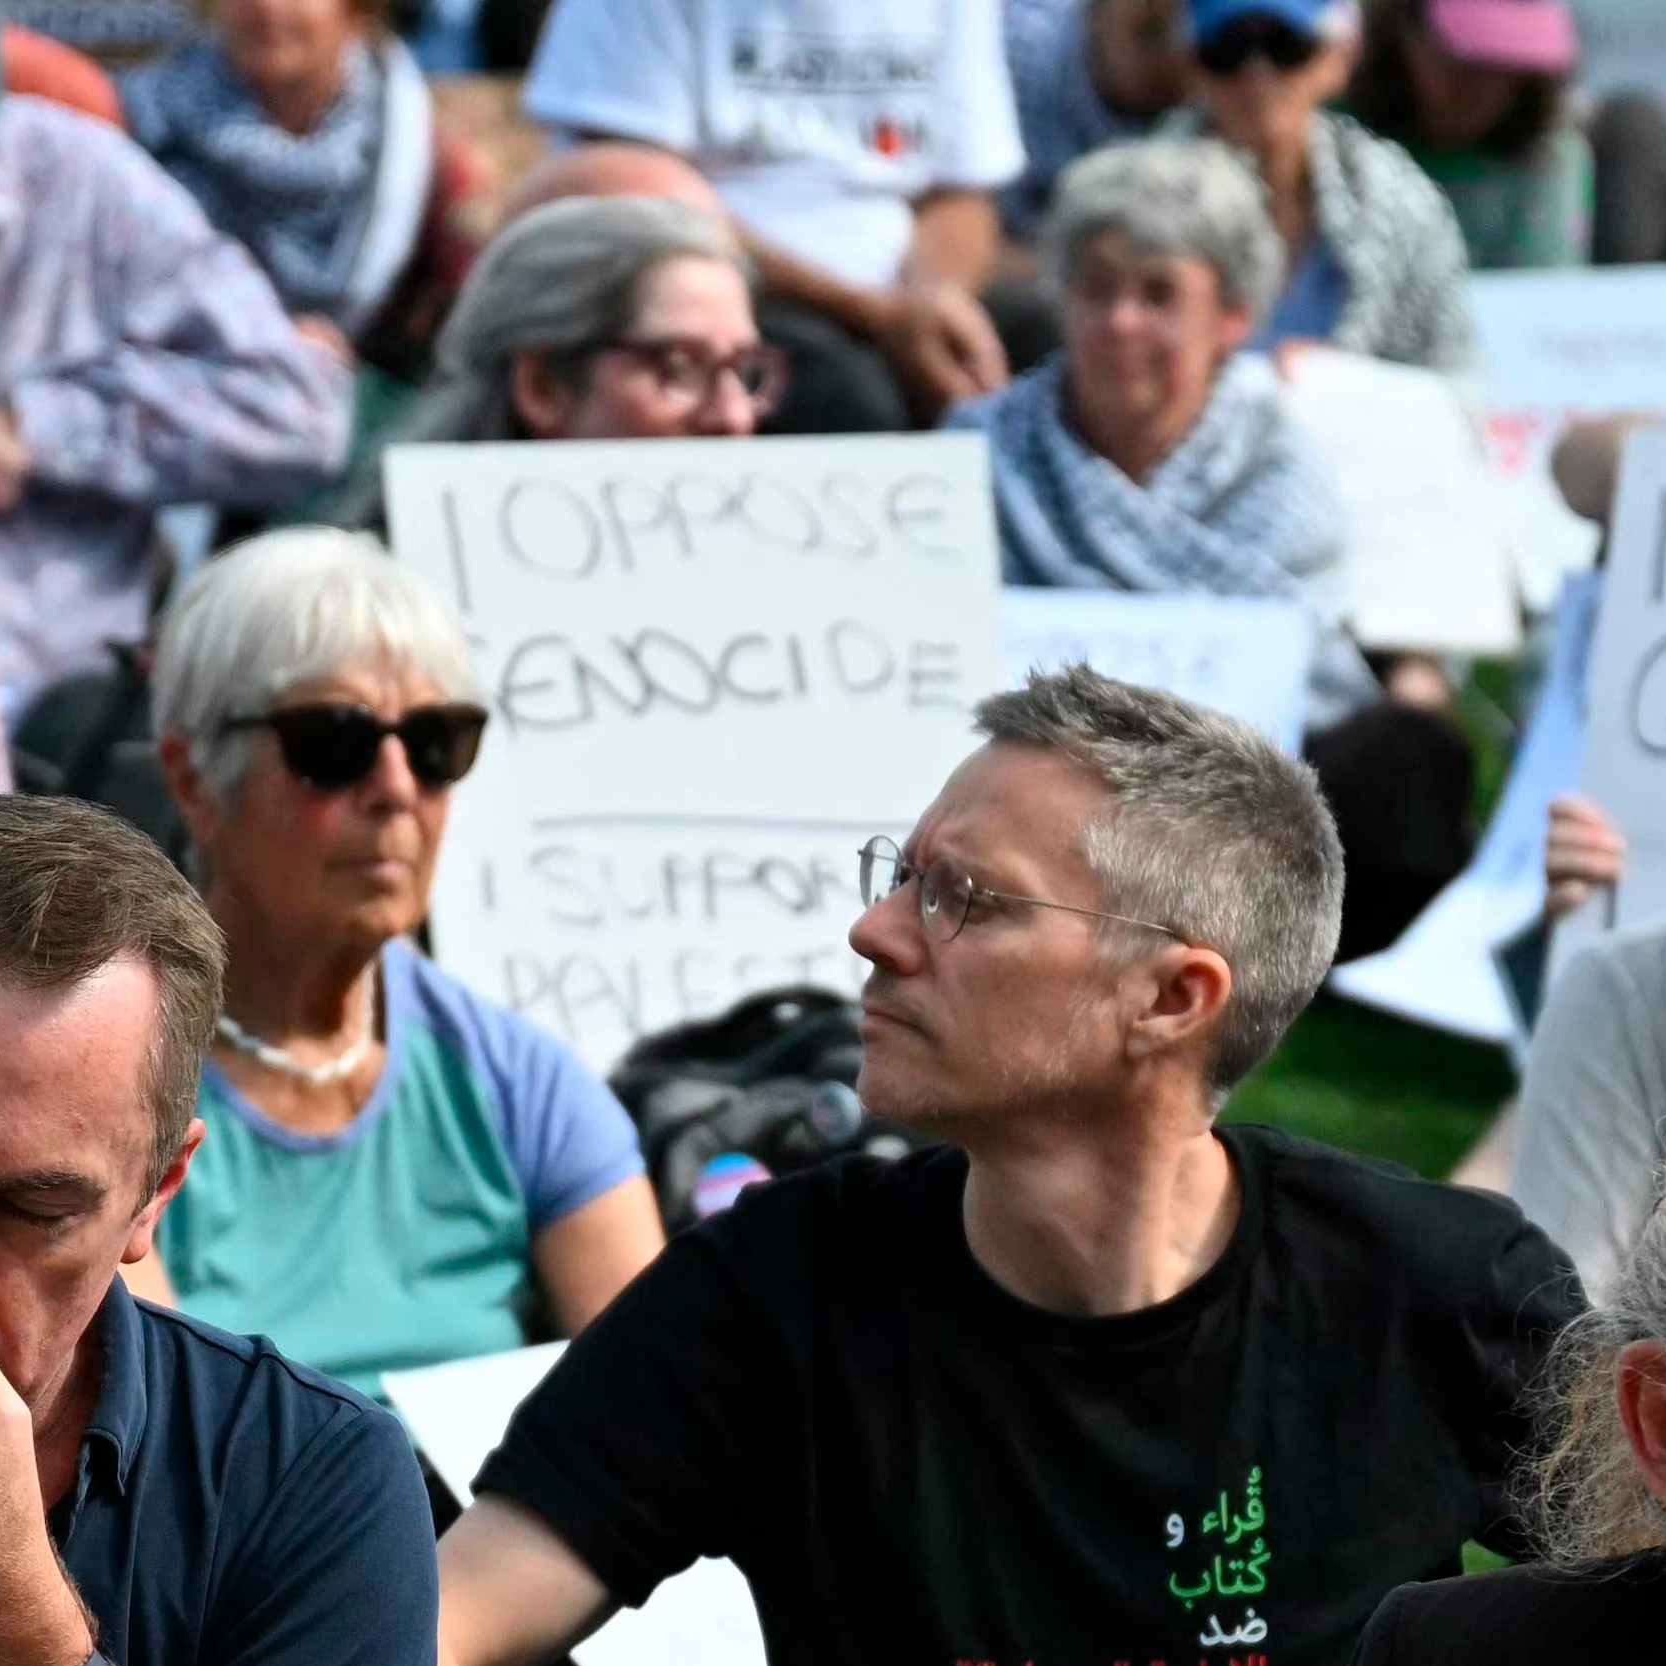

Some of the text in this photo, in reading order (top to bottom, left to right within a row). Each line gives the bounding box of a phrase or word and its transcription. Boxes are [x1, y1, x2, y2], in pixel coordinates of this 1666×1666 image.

[443, 468, 965, 614] I OPPOSE
[471, 616, 970, 742] ENOCIDE
[1199, 1606, 1269, 1647] ضد
